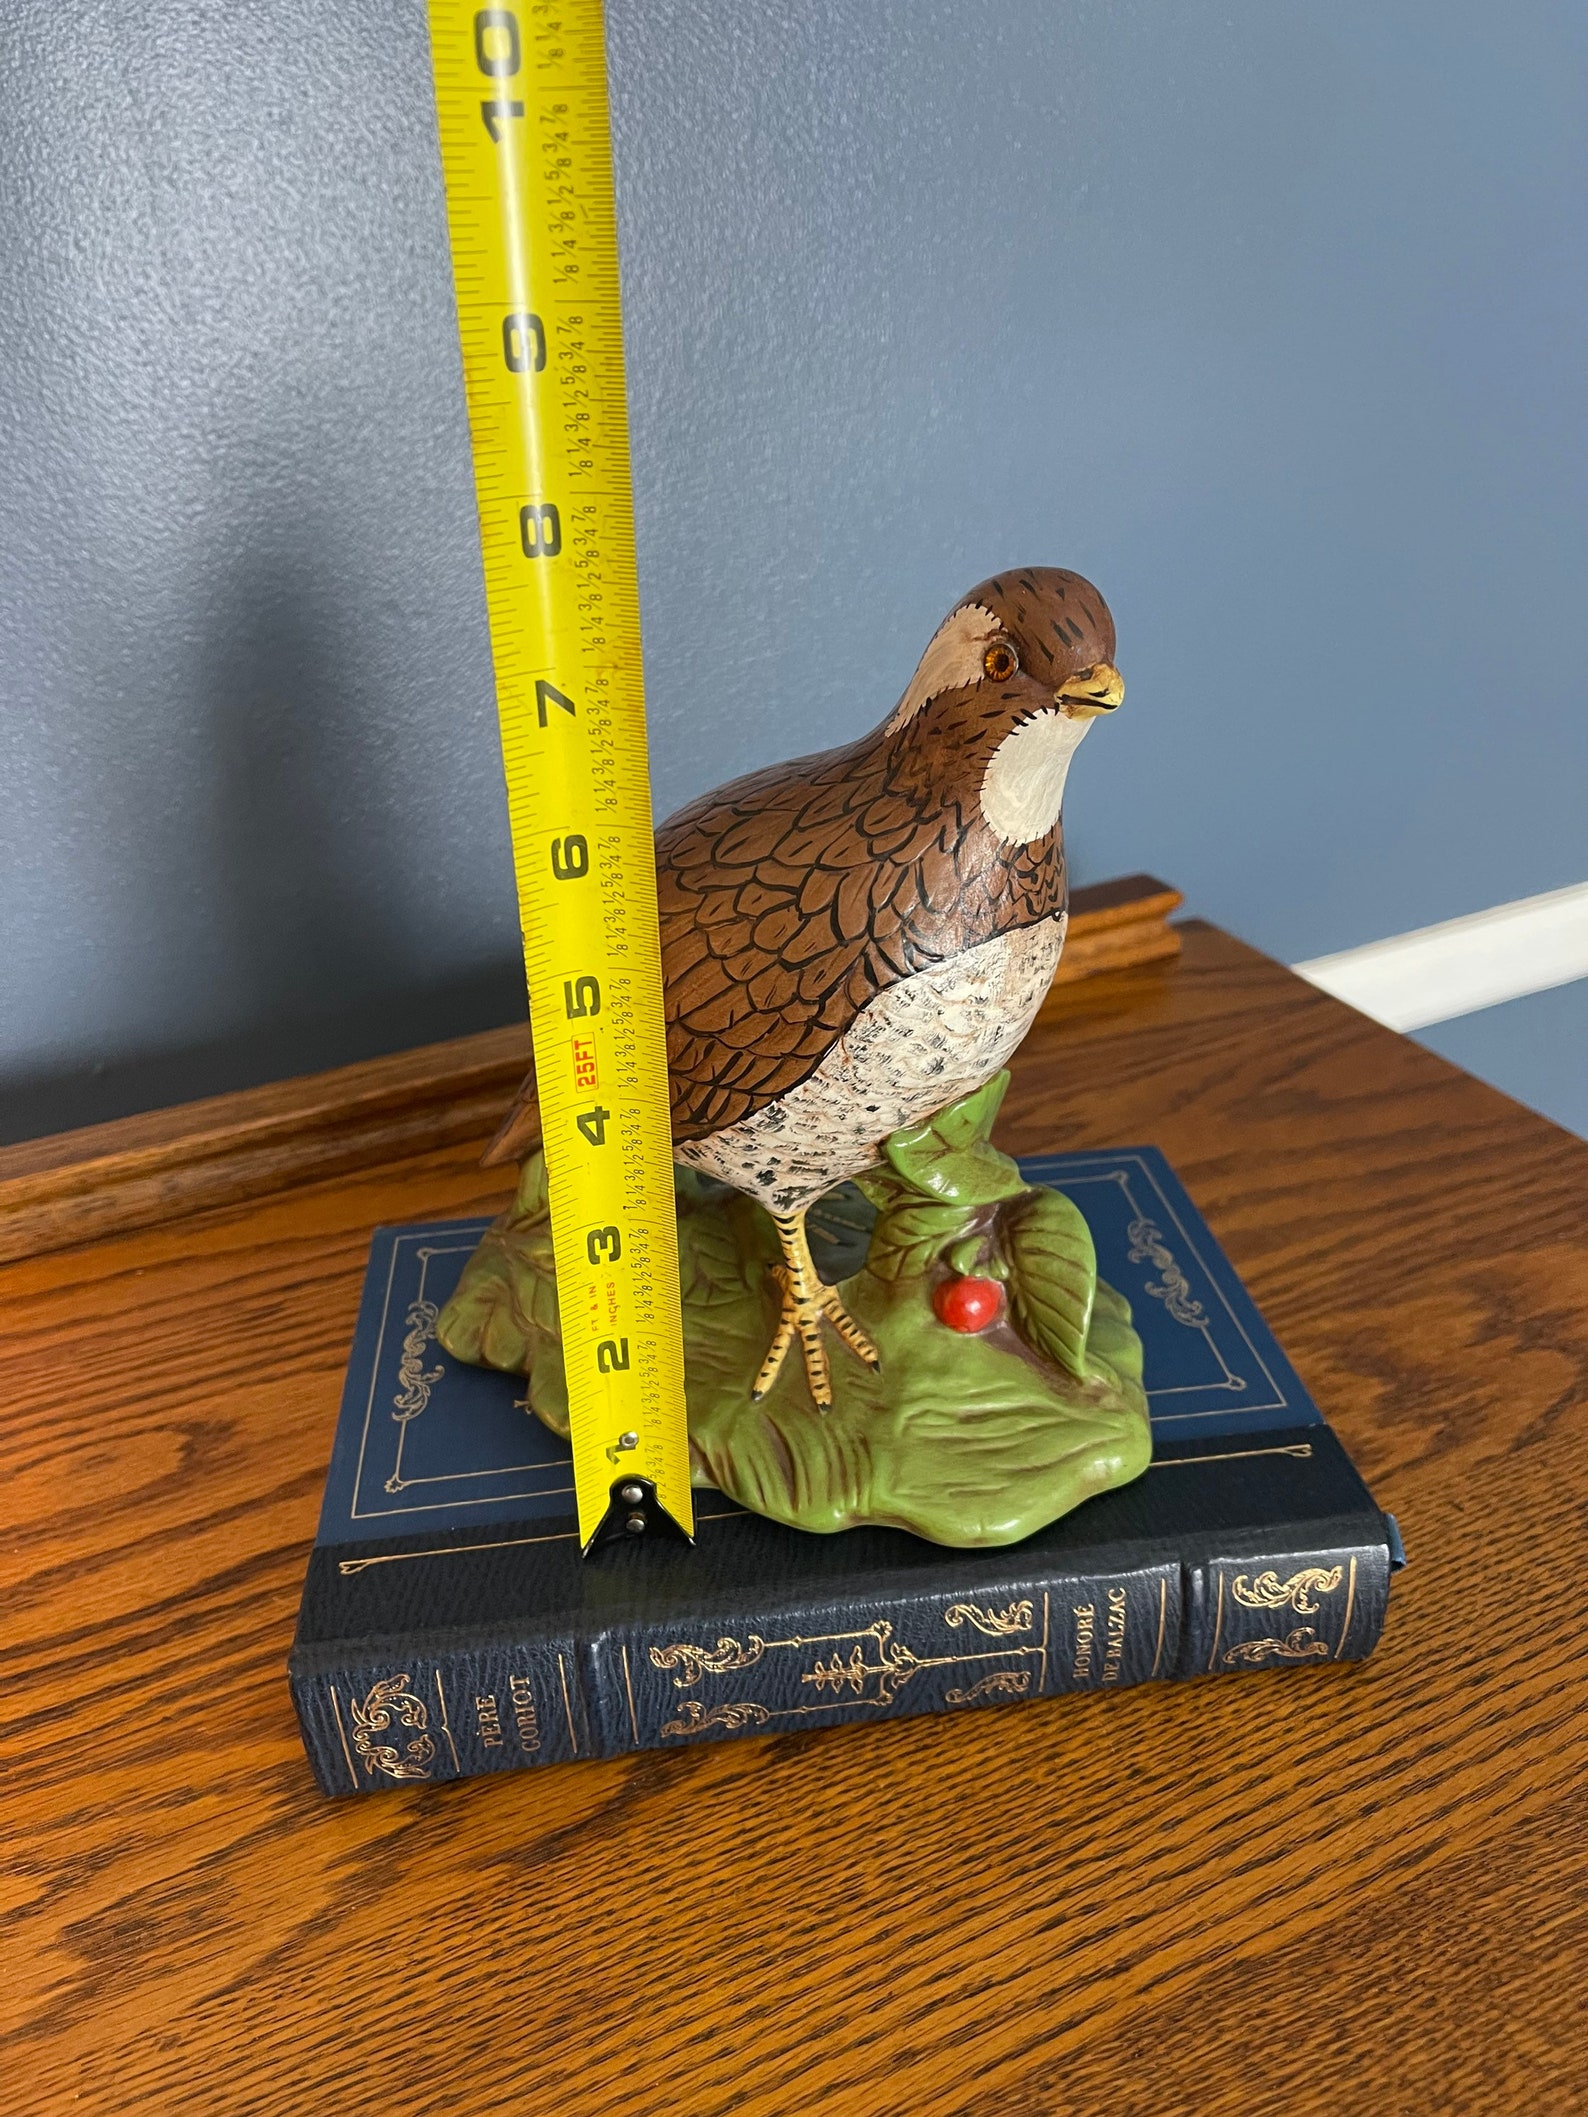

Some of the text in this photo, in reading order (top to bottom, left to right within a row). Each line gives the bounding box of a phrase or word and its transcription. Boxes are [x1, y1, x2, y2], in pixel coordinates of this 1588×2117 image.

[474, 9, 525, 144] 10
[502, 313, 547, 373] 9
[519, 503, 562, 559] 8
[535, 679, 576, 728] 7
[551, 834, 589, 881] 6
[564, 975, 601, 1020] 5
[574, 1039, 596, 1087] 25FT
[576, 1106, 611, 1147] 4
[587, 1225, 622, 1265] 3
[606, 1281, 617, 1327] INCHES
[597, 1337, 630, 1374] 2
[606, 1440, 637, 1465] 1
[1073, 1603, 1095, 1678] HONORÉ
[1102, 1587, 1127, 1682] DE BALZAC
